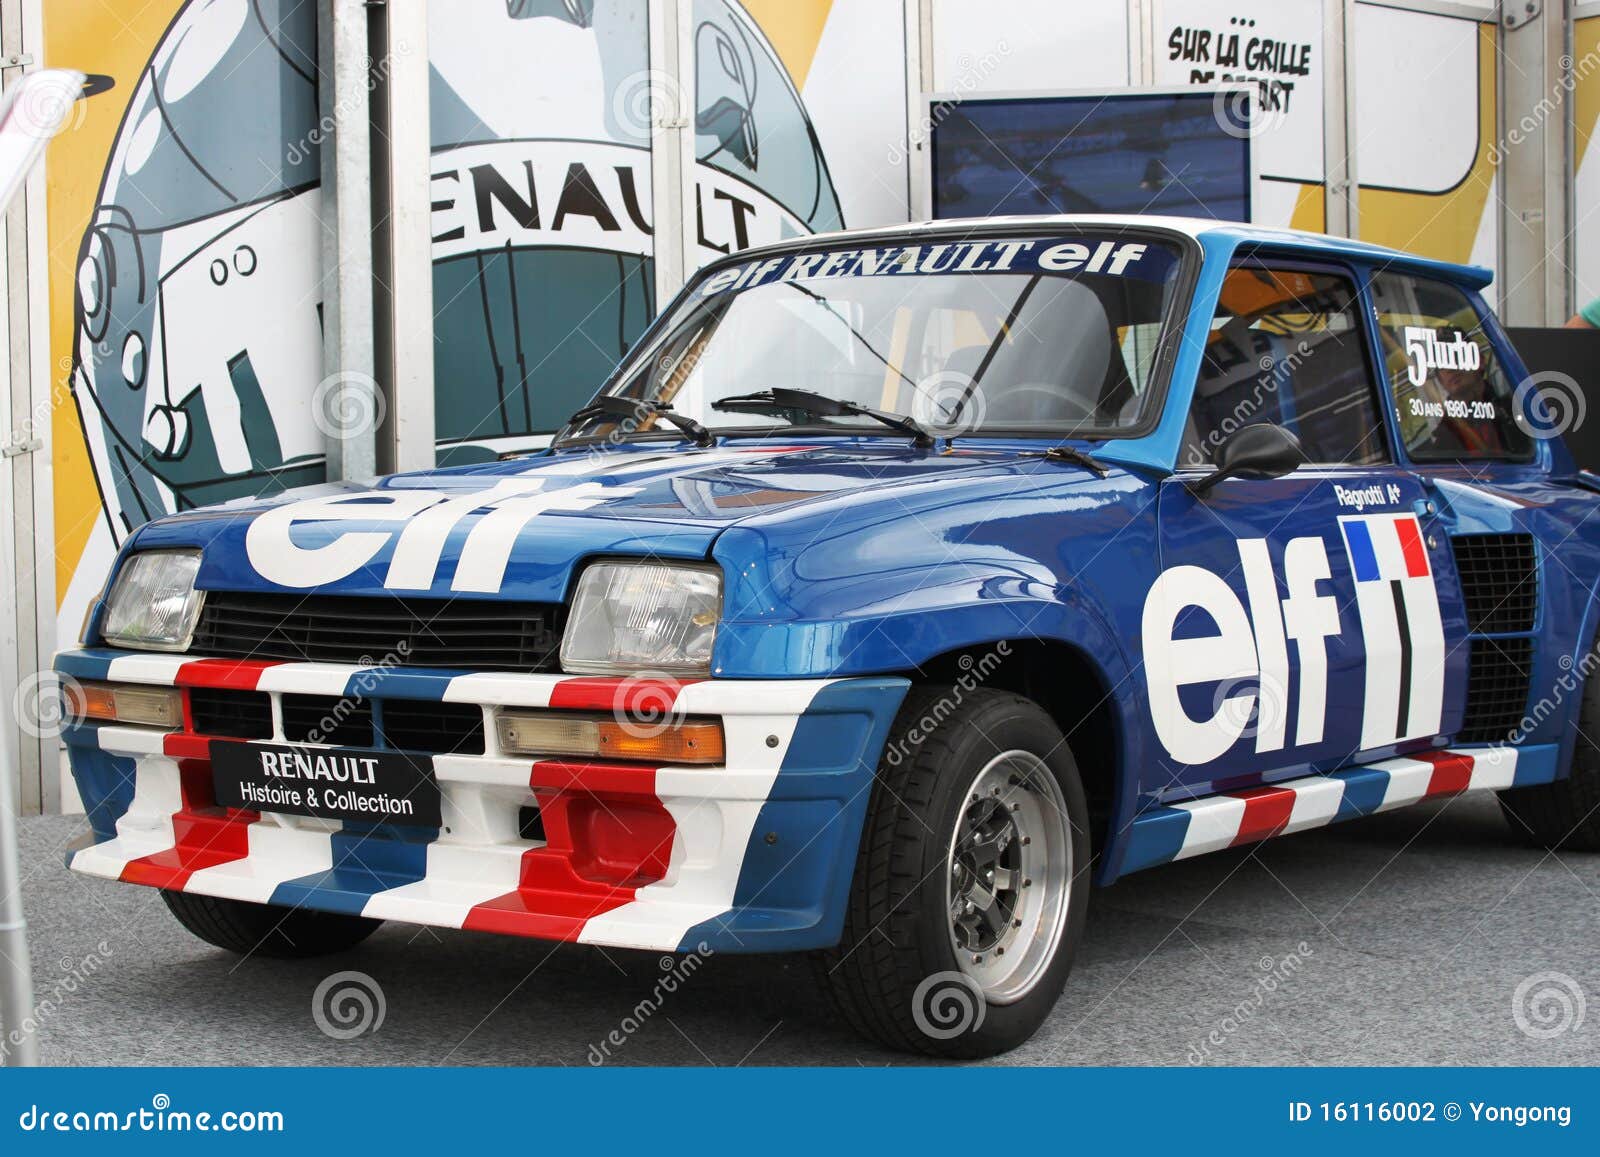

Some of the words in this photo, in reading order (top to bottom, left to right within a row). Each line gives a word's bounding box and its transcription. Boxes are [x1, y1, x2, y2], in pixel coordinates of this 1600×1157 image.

[1168, 26, 1211, 62] SUR
[1216, 33, 1239, 67] LA
[1245, 37, 1311, 76] GRILLE
[1222, 73, 1294, 113] ART
[702, 257, 784, 296] elf
[786, 241, 1034, 280] RENAULT
[1038, 241, 1147, 275] elf
[1409, 398, 1424, 416] 30
[1425, 402, 1444, 418] ANS
[1444, 400, 1495, 419] 1980-2010
[1334, 484, 1386, 511] Ragnotti
[246, 478, 647, 593] elf
[1141, 536, 1341, 765] elf
[260, 752, 379, 784] RENAULT
[240, 781, 301, 806] Histoire
[307, 787, 319, 807] &
[324, 788, 413, 815] Collection
